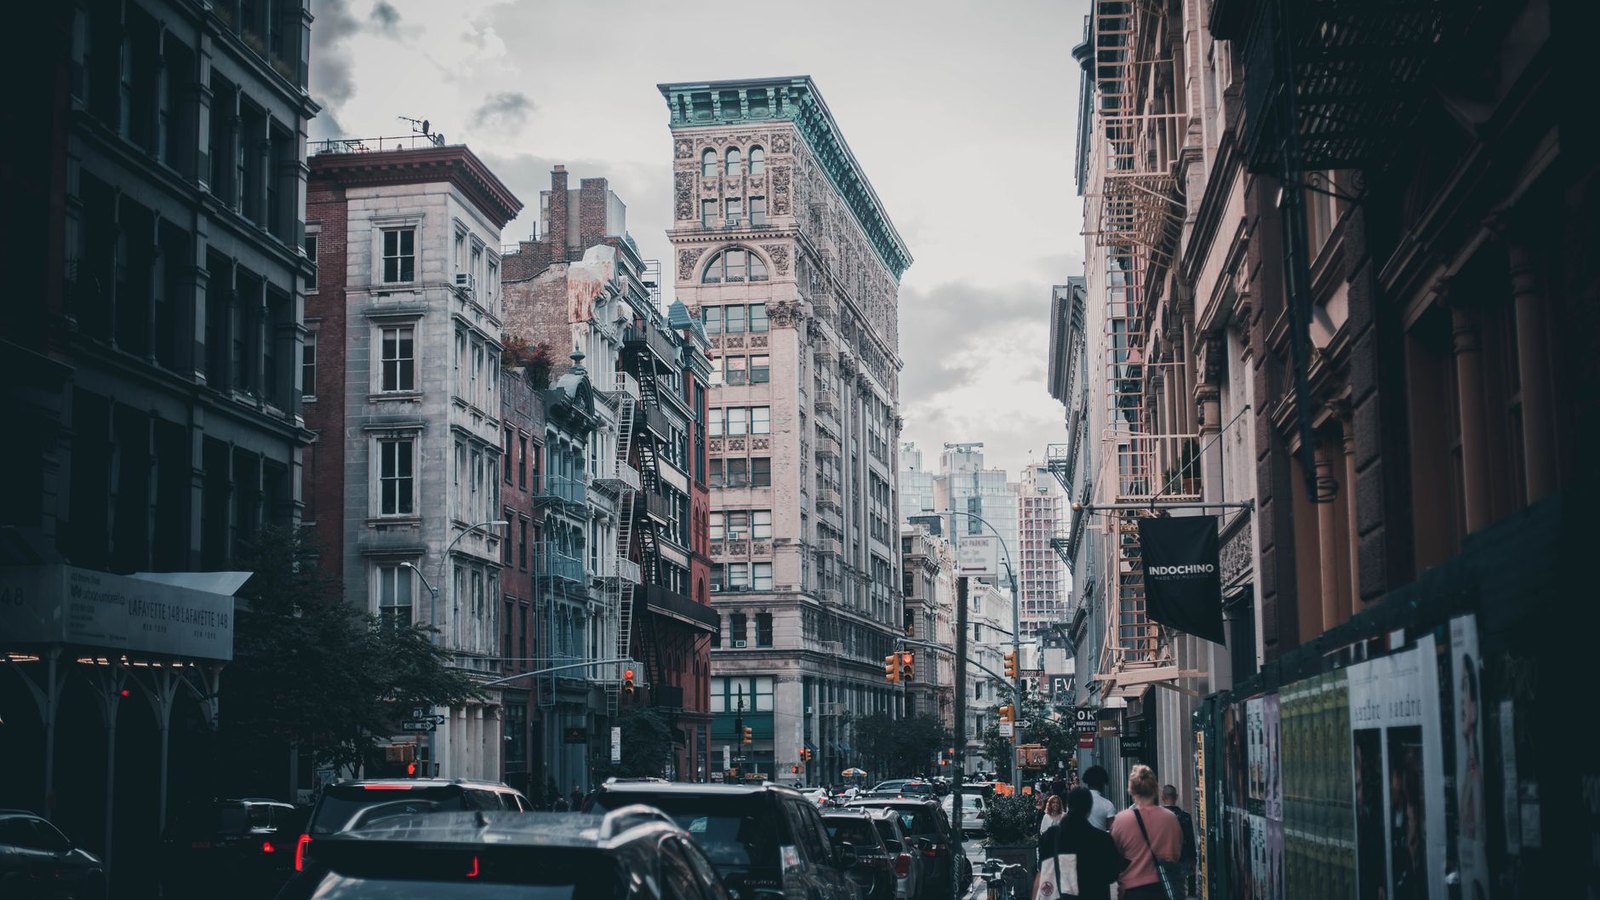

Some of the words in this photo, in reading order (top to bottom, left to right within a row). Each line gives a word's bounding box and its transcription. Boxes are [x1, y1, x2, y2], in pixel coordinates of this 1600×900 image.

[1148, 563, 1215, 576] INDOCHINO
[128, 599, 166, 620] LAFAYETTE
[167, 605, 181, 622] 148
[181, 607, 215, 628] LAFAYETTE
[217, 612, 228, 630] 148
[1077, 710, 1097, 721] OK
